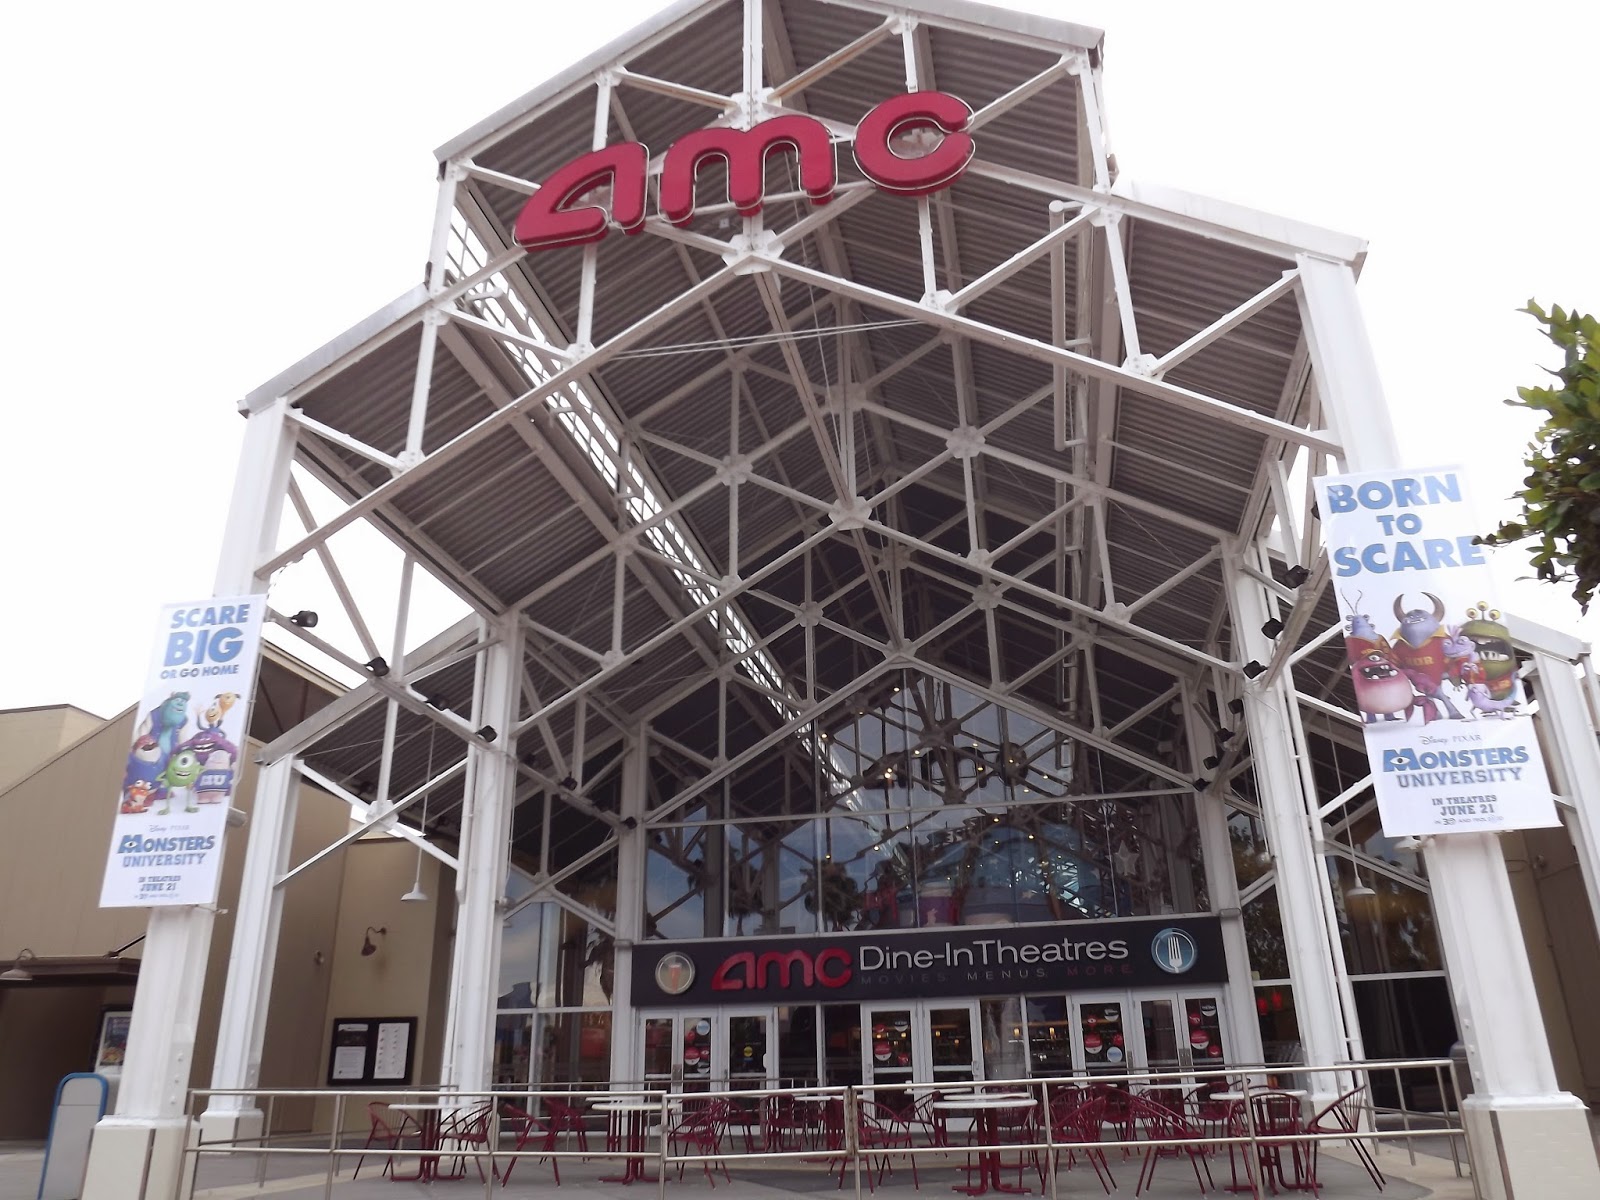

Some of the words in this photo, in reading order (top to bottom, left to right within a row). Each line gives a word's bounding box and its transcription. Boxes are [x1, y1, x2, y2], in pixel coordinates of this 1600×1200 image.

[1326, 473, 1463, 514] BORN
[1376, 513, 1423, 537] TO
[1334, 535, 1486, 578] SCARE
[170, 603, 250, 629] SCARE
[163, 627, 244, 667] BIG
[160, 669, 178, 680] OR
[180, 667, 200, 678] GO
[201, 664, 240, 677] HOME
[1383, 746, 1529, 772] MONSTERS
[1396, 767, 1523, 788] UNIVERSITY
[1432, 797, 1443, 806] IN
[1446, 795, 1497, 805] THEATRES
[1440, 805, 1476, 817] JUNE
[1480, 803, 1495, 815] 21
[117, 834, 216, 854] MONSTERS
[122, 852, 207, 868] UNIVERSITY
[140, 882, 164, 892] JUNE
[166, 882, 176, 891] 21
